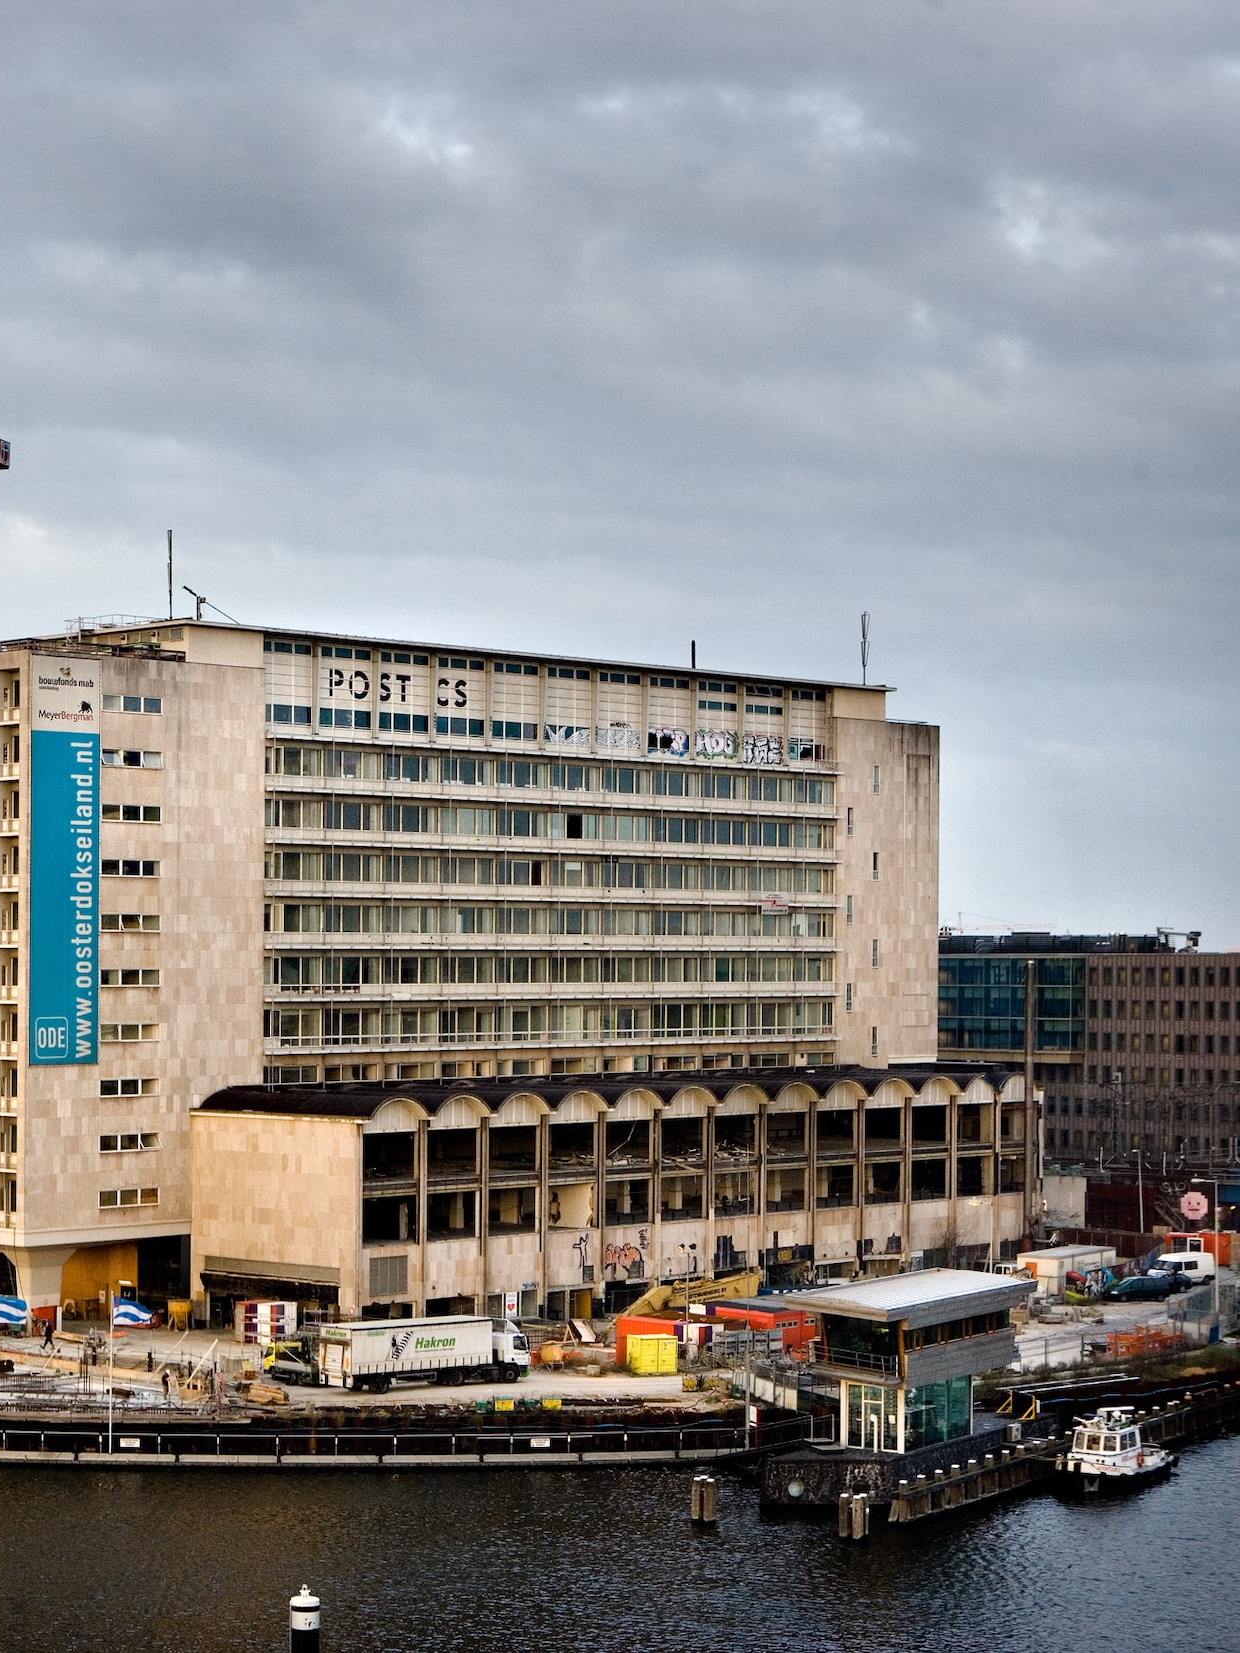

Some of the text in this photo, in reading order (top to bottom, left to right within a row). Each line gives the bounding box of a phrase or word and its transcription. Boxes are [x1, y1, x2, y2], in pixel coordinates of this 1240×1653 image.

[38, 675, 94, 688] bouwfonds mab
[328, 668, 468, 708] POST CS
[38, 709, 94, 723] MeyerBergman
[70, 741, 93, 1059] www.oosterdokseiland.nl
[38, 1027, 66, 1049] ODE
[325, 1329, 347, 1338] Hakron
[415, 1336, 456, 1349] Hakron
